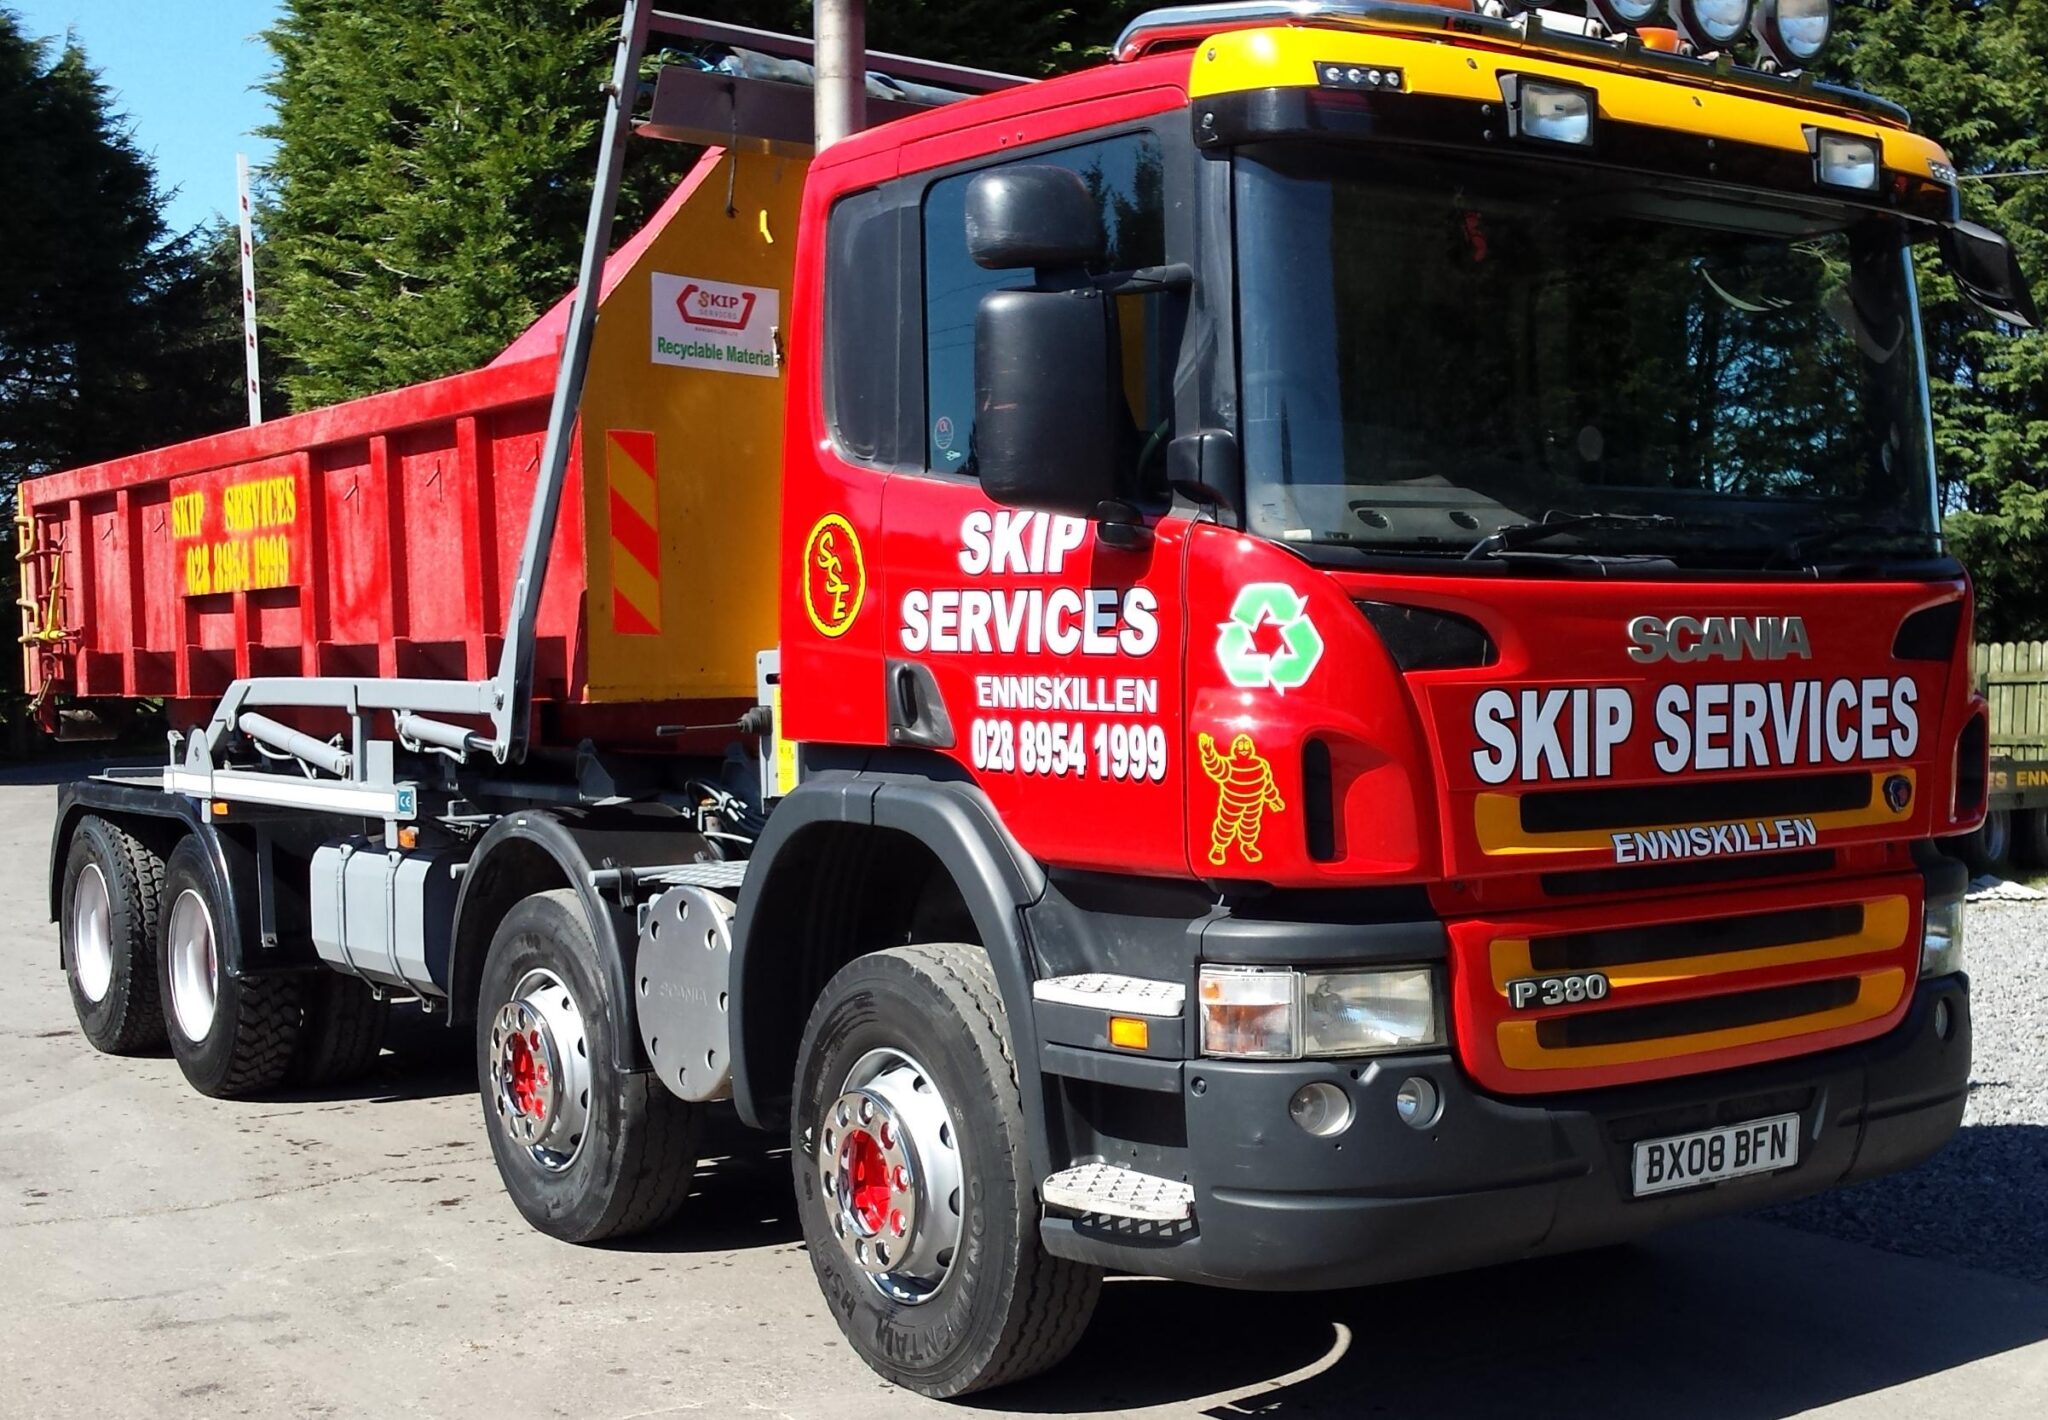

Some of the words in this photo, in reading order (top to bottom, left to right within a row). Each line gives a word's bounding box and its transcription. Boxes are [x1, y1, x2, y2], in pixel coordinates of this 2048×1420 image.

[698, 291, 739, 308] SKIP
[657, 336, 723, 360] Recyclable
[173, 492, 204, 538] SKIP
[224, 476, 295, 531] SERVICES
[959, 509, 1088, 576] SKIP
[900, 586, 1159, 657] SERVICES
[1626, 615, 1812, 664] SCANIA
[975, 675, 1158, 714] ENNISKILLEN
[971, 717, 1016, 773] 028
[1019, 722, 1086, 778] 8954
[1094, 723, 1168, 783] 1999
[1471, 686, 1634, 785] SKIP
[1652, 675, 1921, 774] SERVICES
[1611, 817, 1818, 864] ENNISKILLEN
[659, 982, 708, 1006] SCANIA
[1515, 982, 1538, 1008] P
[1541, 973, 1607, 1005] 380
[1646, 1134, 1726, 1185] BX08
[1733, 1121, 1788, 1168] BFN
